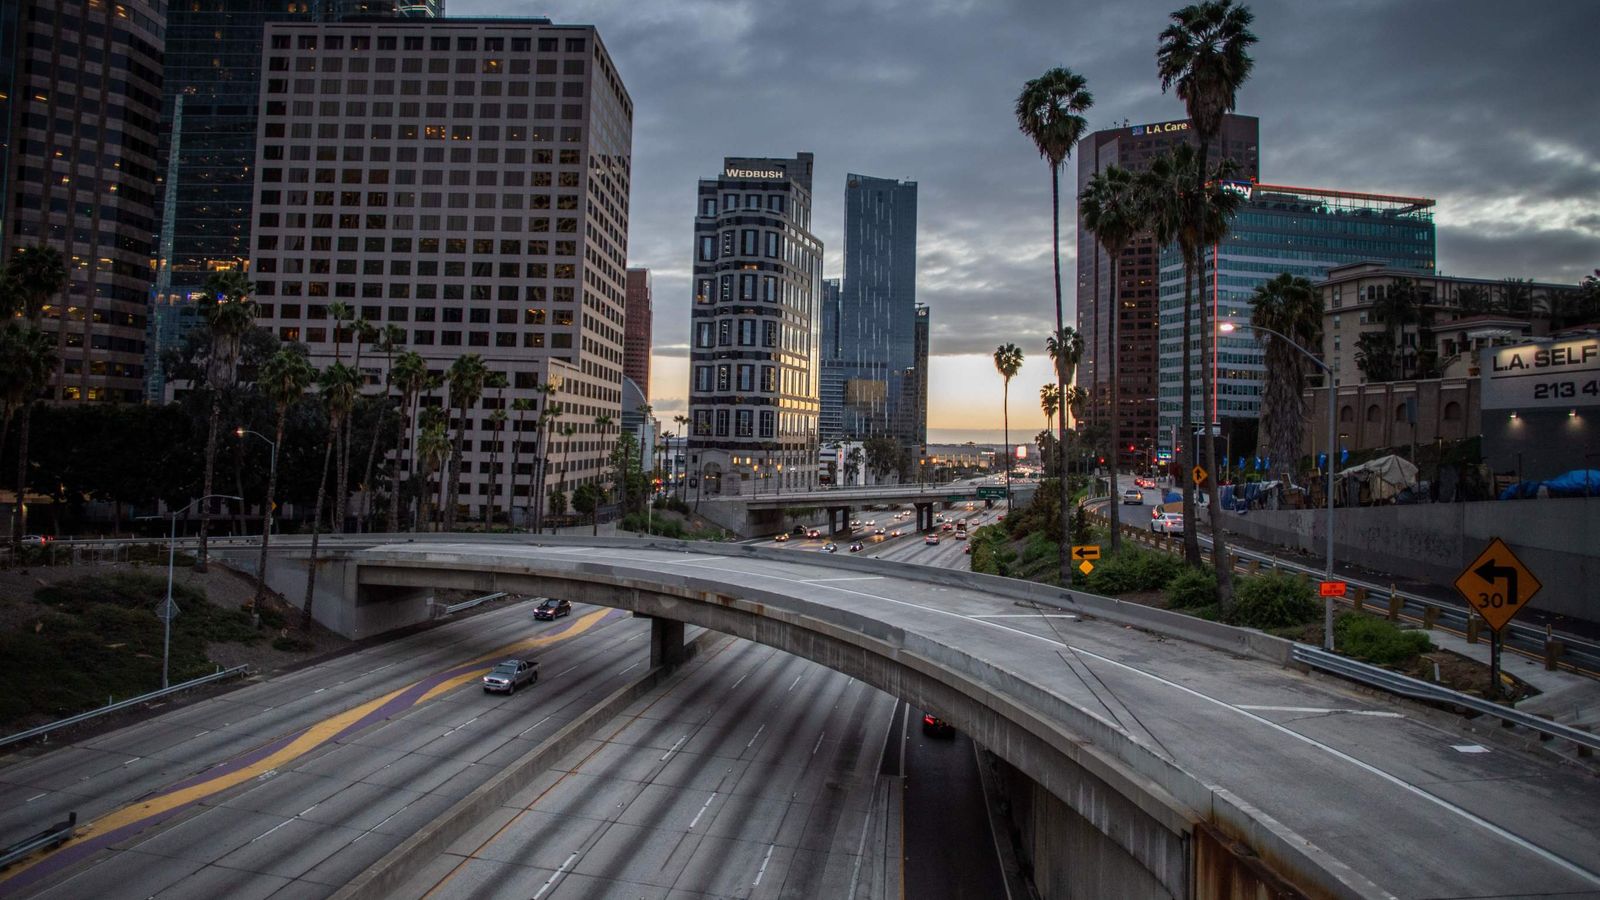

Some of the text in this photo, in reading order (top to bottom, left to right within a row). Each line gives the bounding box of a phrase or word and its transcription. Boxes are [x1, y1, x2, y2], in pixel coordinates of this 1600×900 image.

[1164, 122, 1188, 132] Care
[726, 168, 783, 179] WEDBUSH
[1493, 344, 1598, 372] L.A. SELF
[1534, 380, 1600, 399] 213 4
[1478, 592, 1504, 609] 30
